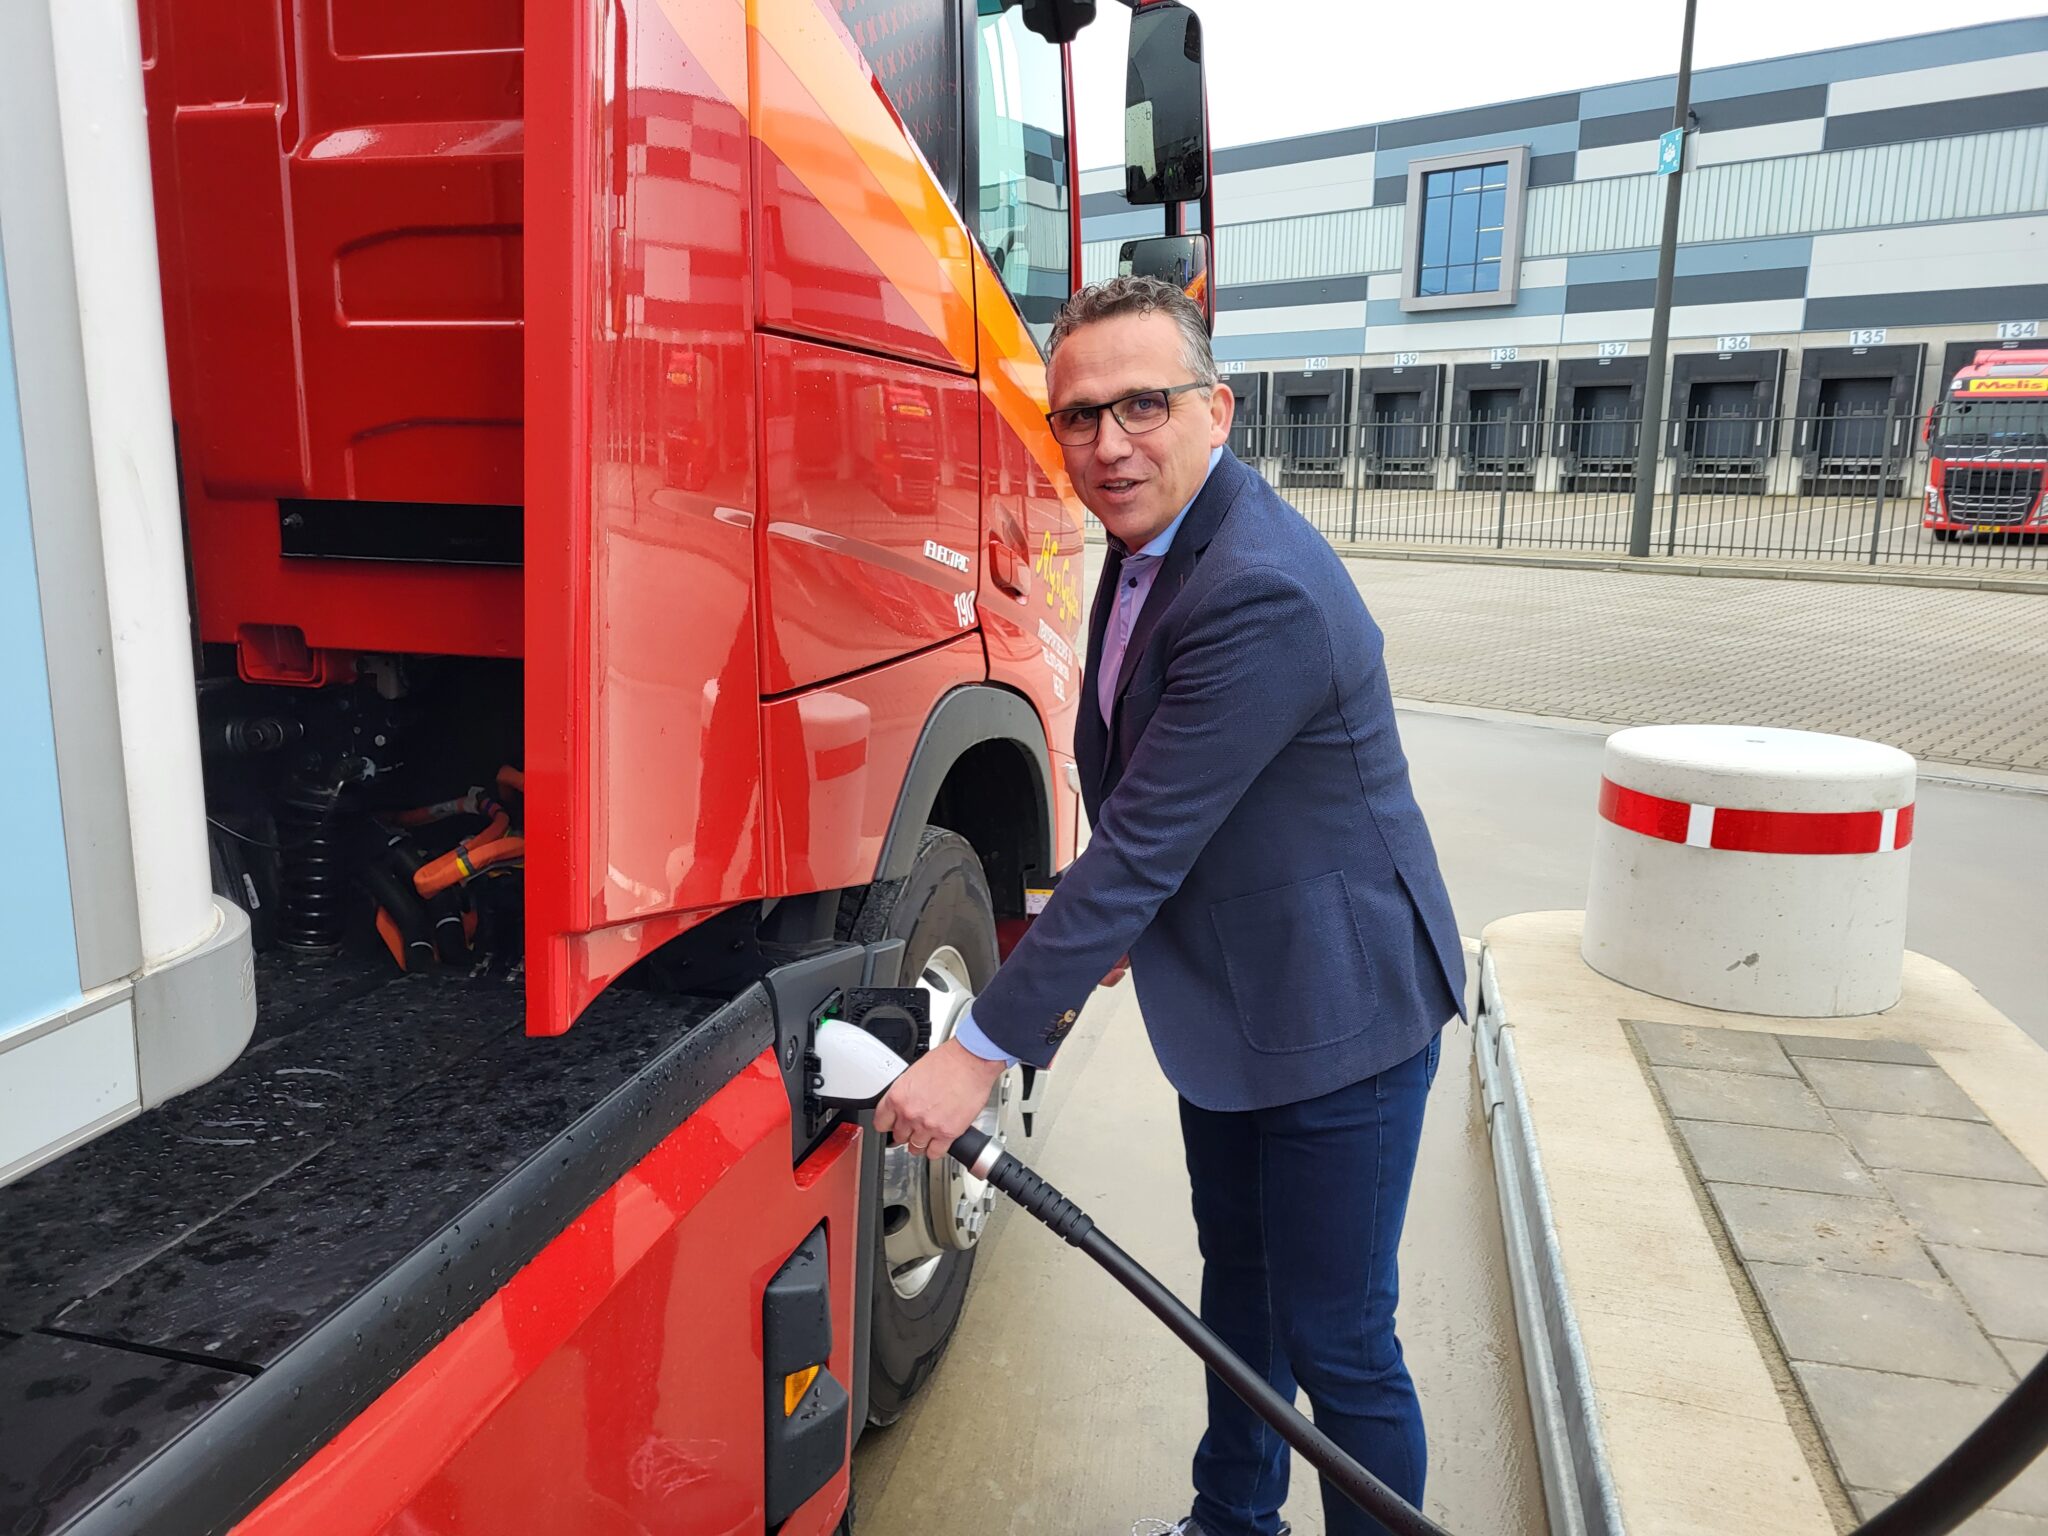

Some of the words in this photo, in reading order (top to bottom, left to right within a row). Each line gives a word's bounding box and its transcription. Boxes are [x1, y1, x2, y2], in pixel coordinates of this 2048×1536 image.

[2000, 322, 2036, 338] 134
[1719, 337, 1748, 350] 136
[1852, 330, 1884, 345] 135
[1492, 348, 1516, 361] 138
[1600, 343, 1626, 356] 137
[1306, 358, 1327, 369] 140
[1396, 354, 1418, 366] 139
[1227, 362, 1245, 372] 141
[1975, 380, 2043, 390] Melis
[924, 540, 969, 573] ELECTRIC
[953, 590, 976, 628] 190
